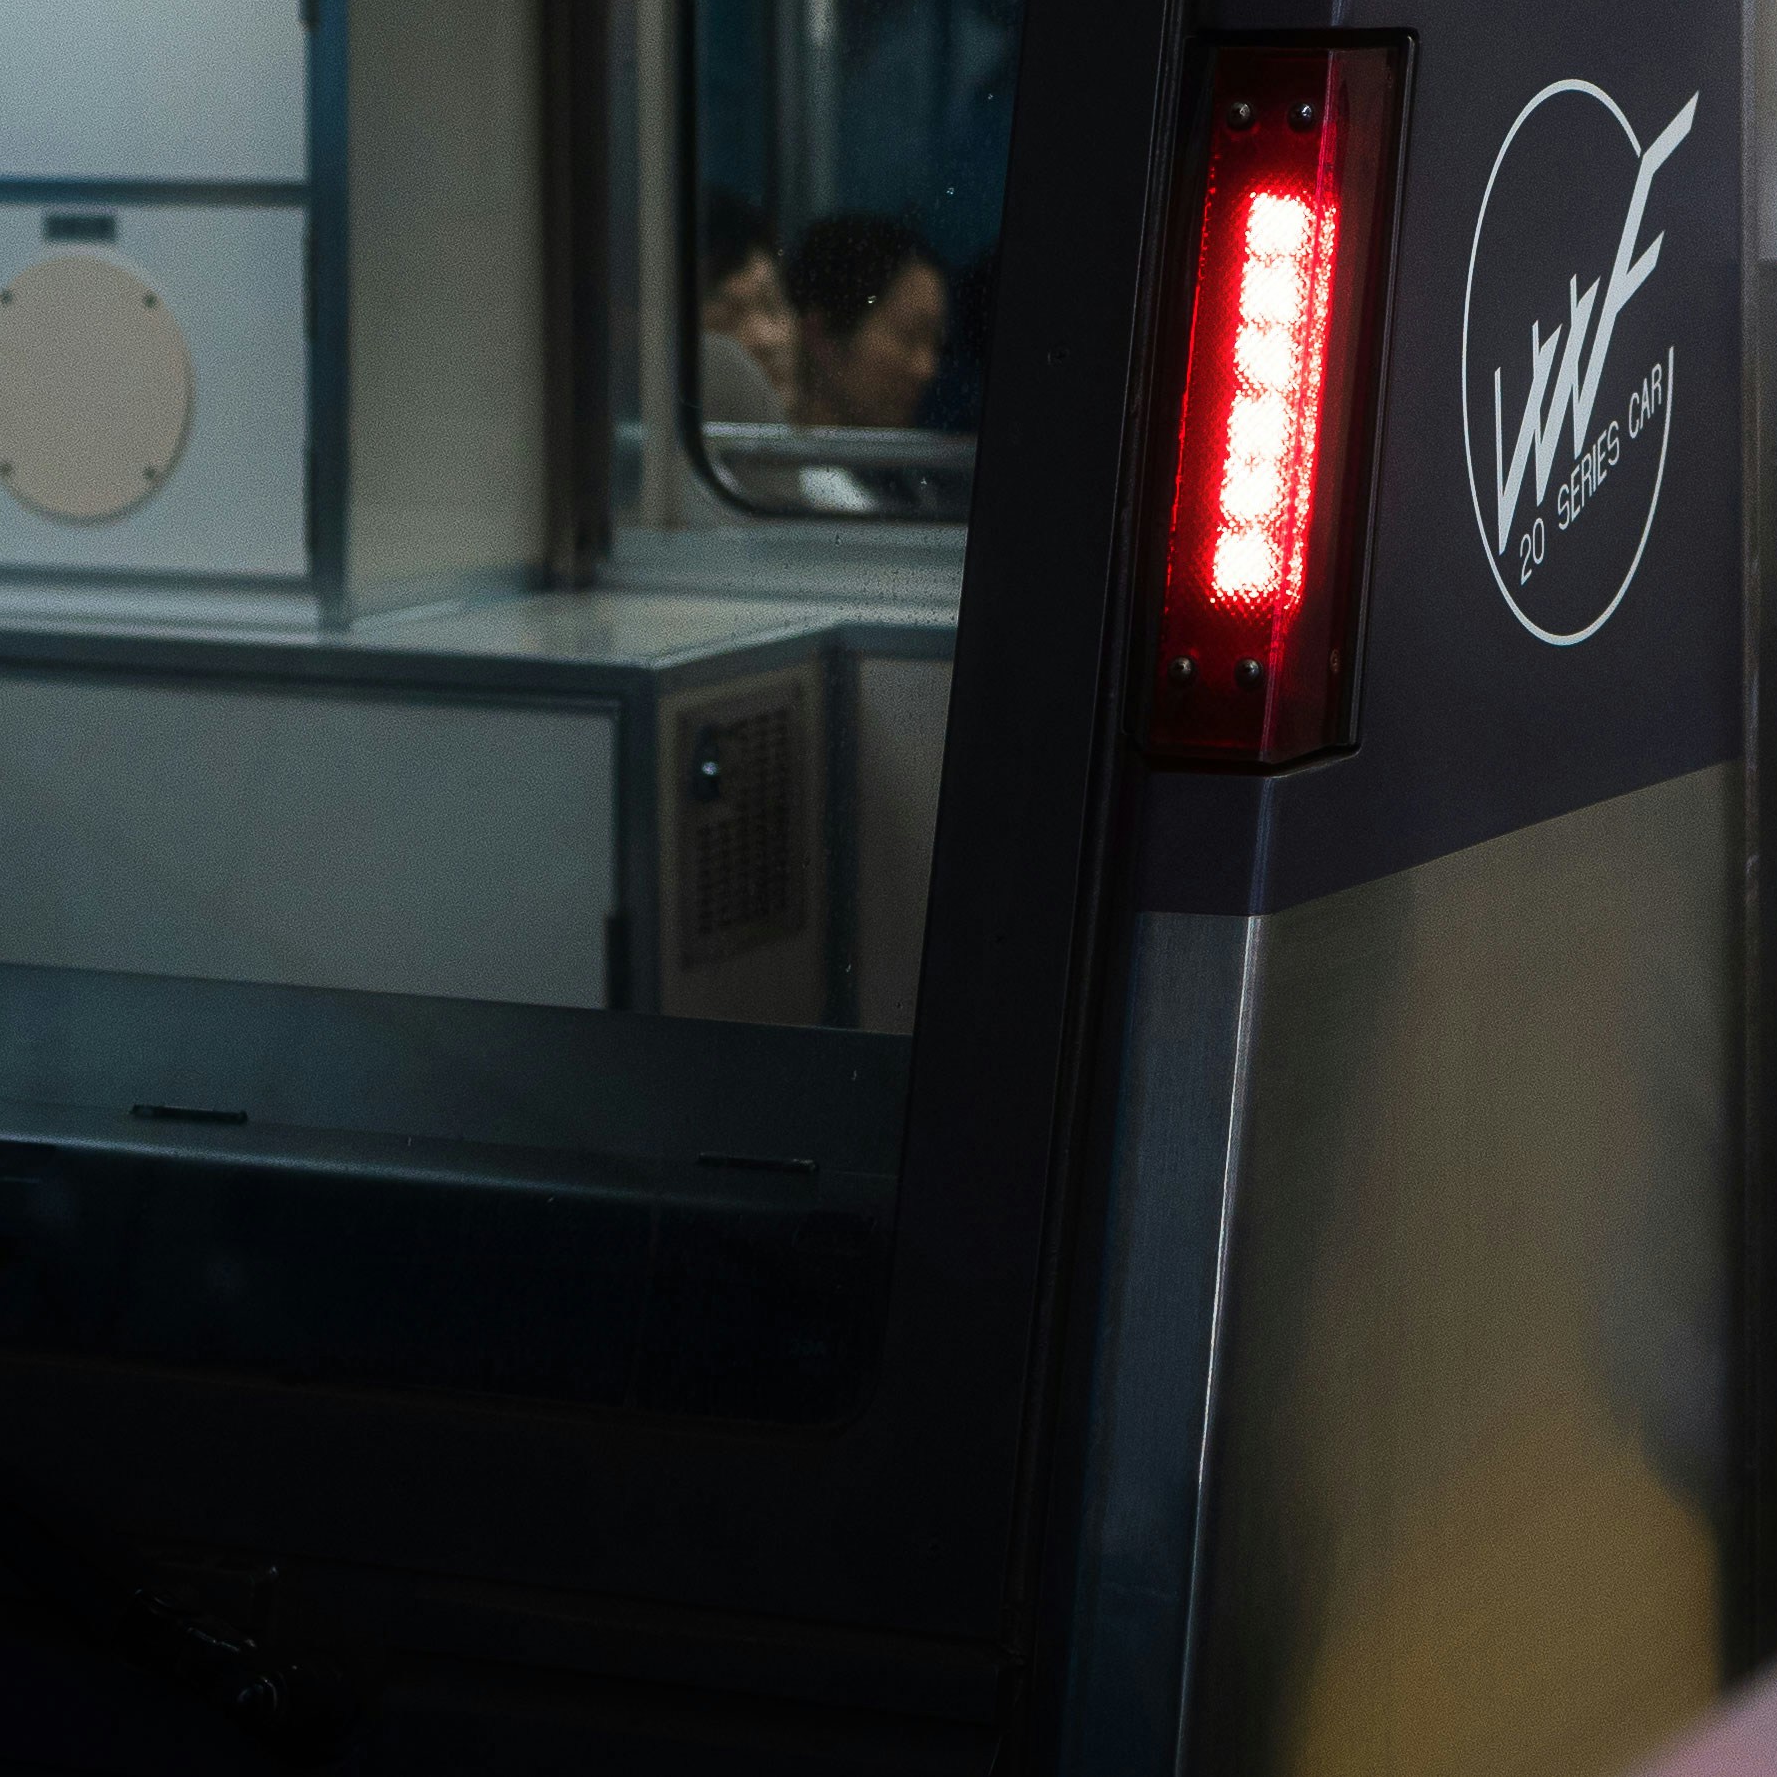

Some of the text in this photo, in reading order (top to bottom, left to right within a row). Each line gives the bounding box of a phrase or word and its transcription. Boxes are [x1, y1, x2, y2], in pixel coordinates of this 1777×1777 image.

[1519, 363, 1662, 586] 20 SERIES CAR
